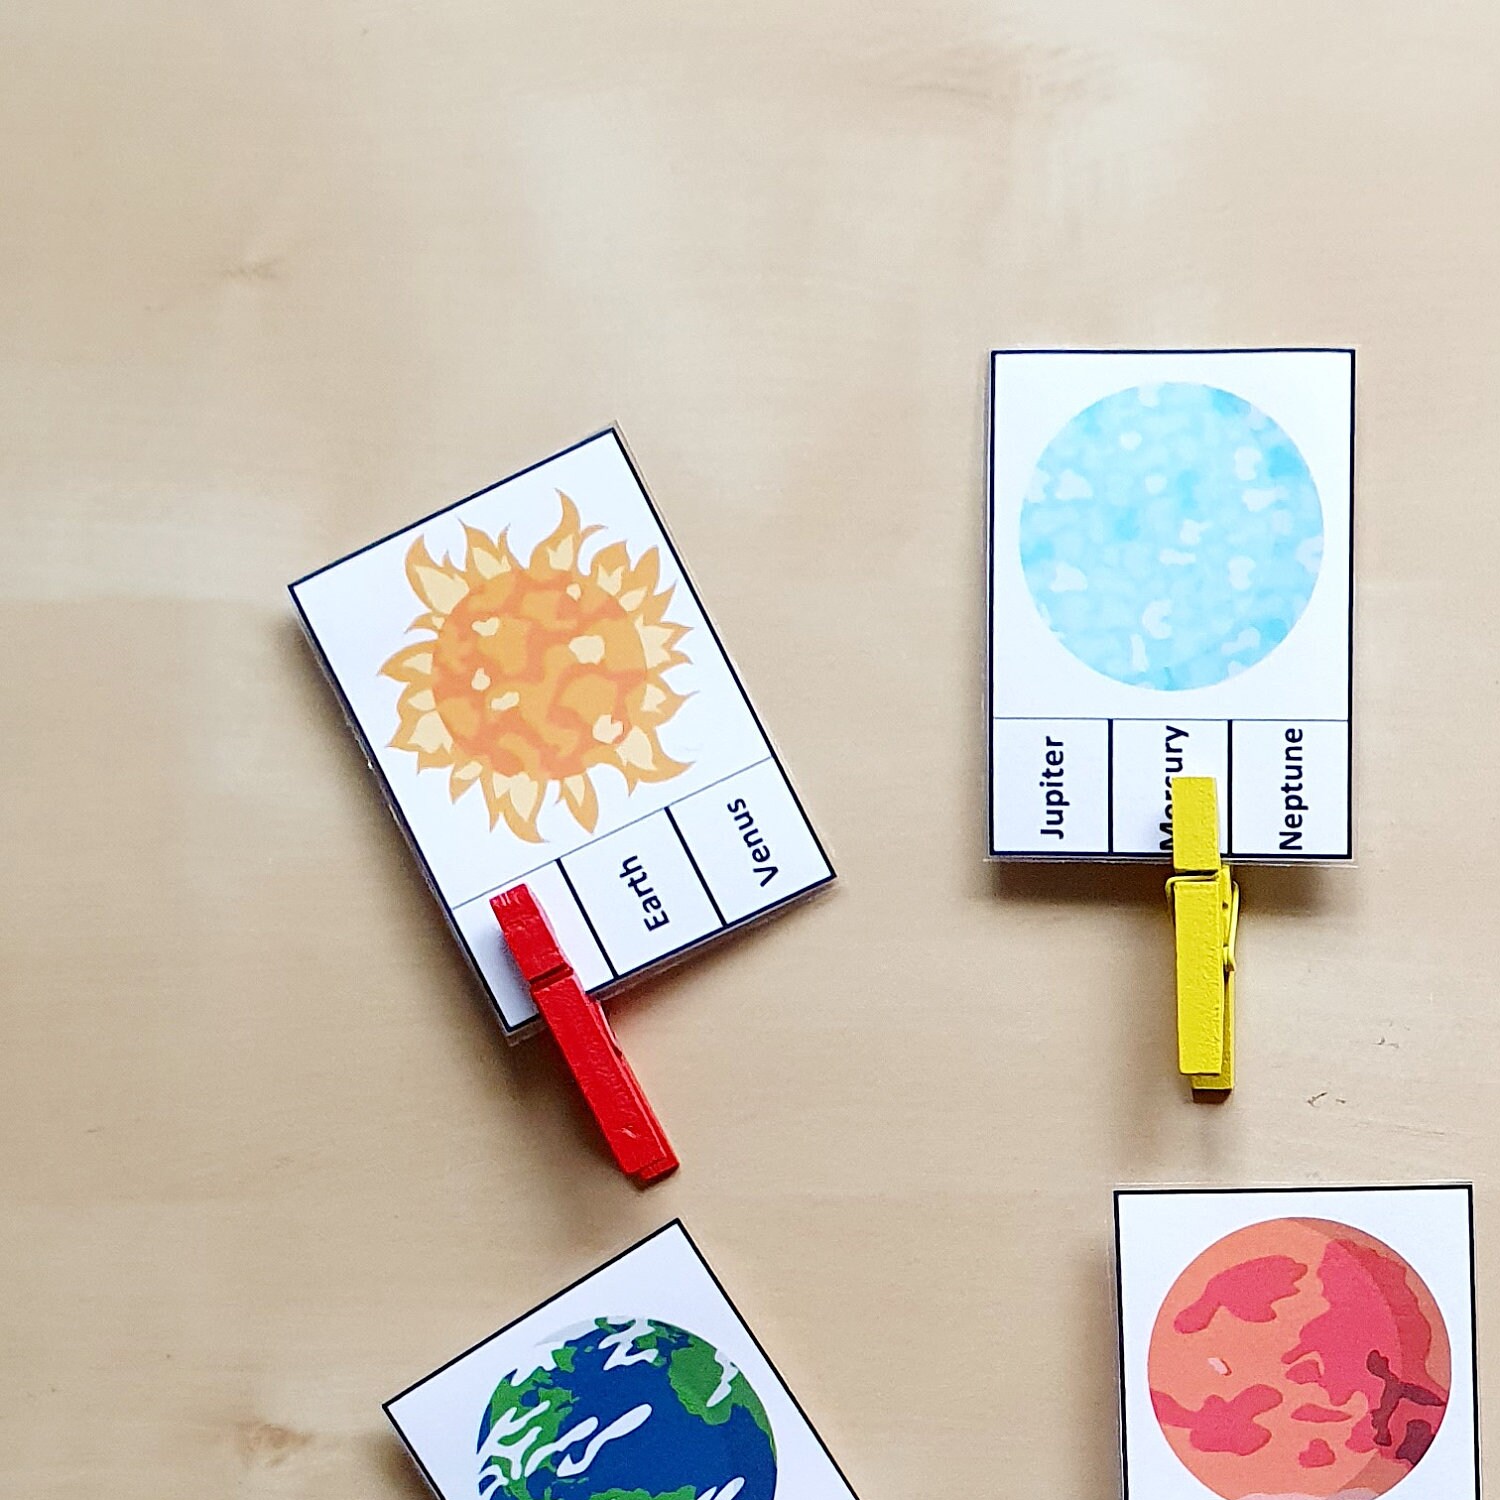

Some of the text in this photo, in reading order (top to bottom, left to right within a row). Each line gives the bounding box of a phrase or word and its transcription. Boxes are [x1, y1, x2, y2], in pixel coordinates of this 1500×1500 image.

[1039, 735, 1070, 840] Jupiter
[1279, 727, 1309, 850] Neptune
[726, 798, 779, 888] Venus
[619, 854, 670, 932] Earth
